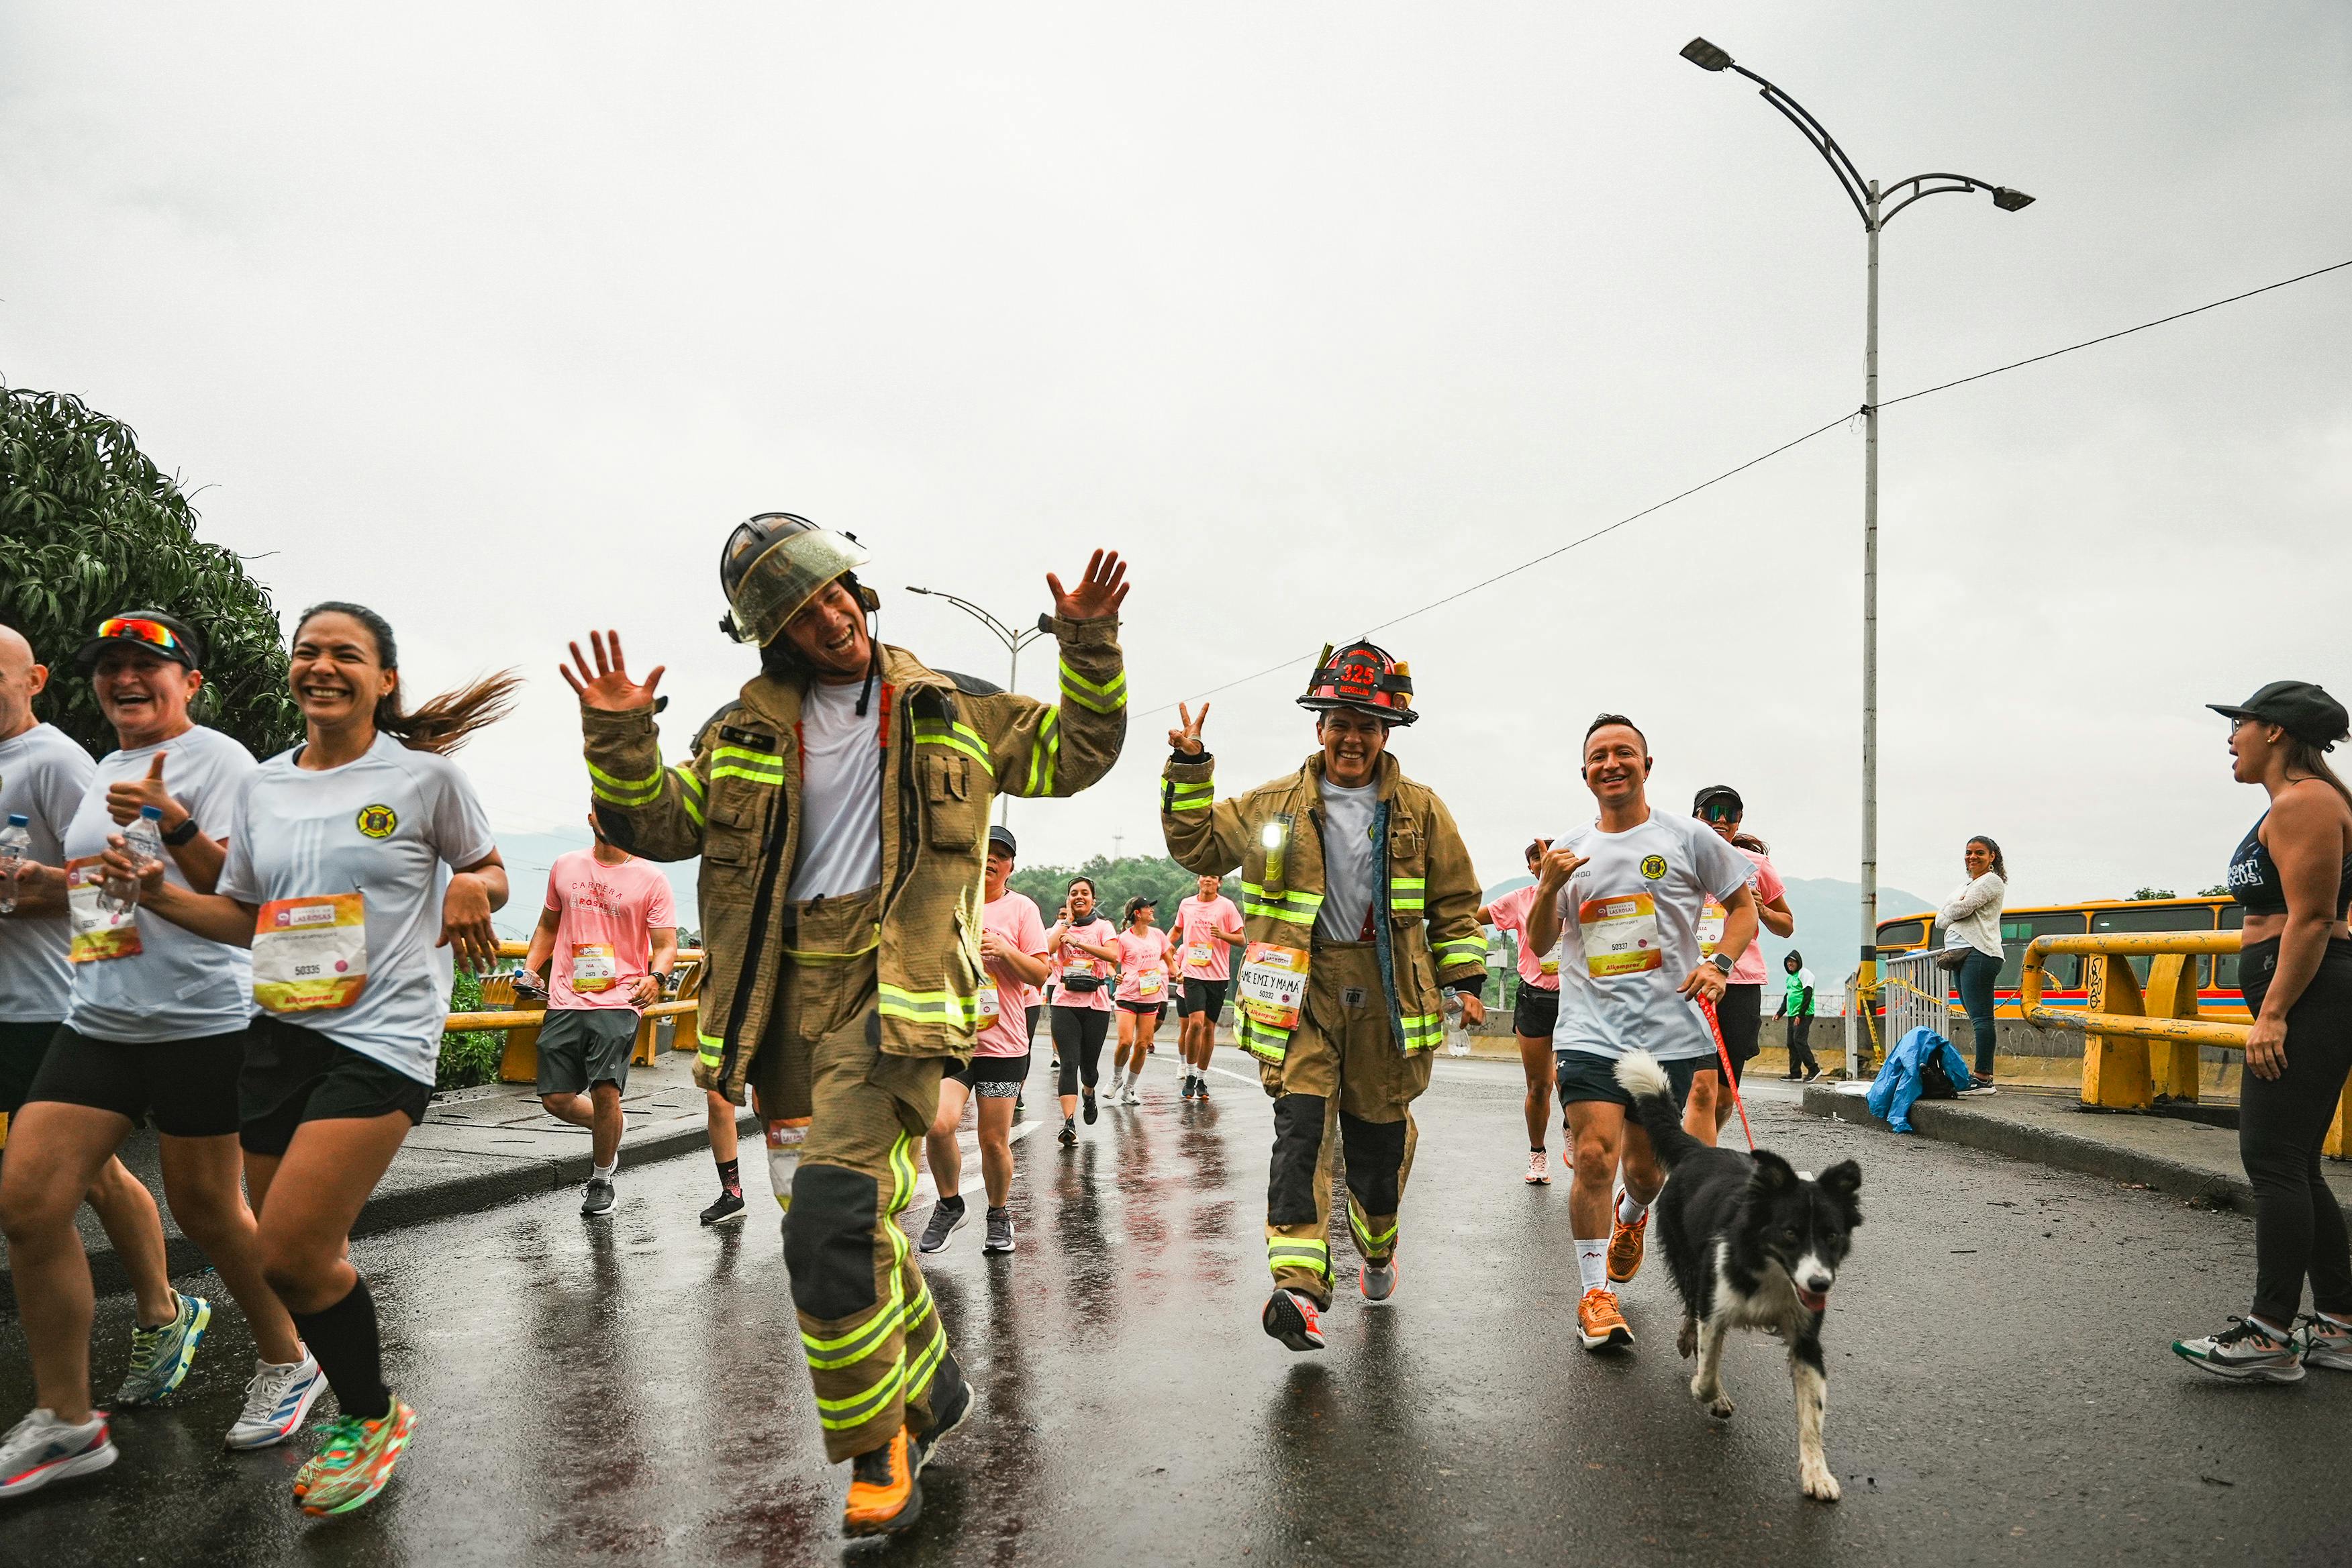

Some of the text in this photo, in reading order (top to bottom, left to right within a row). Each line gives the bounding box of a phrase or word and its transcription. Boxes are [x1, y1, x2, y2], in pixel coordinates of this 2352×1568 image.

[1340, 664, 1375, 685] 325
[1569, 871, 1591, 881] ARDO
[572, 881, 623, 900] CARRERA
[579, 897, 608, 910] ROSAS
[1612, 942, 1628, 951] 50337
[1253, 972, 1269, 987] EMI
[1271, 977, 1276, 988] Y
[1276, 978, 1301, 993] MAMÁ
[1259, 990, 1274, 999] 50332
